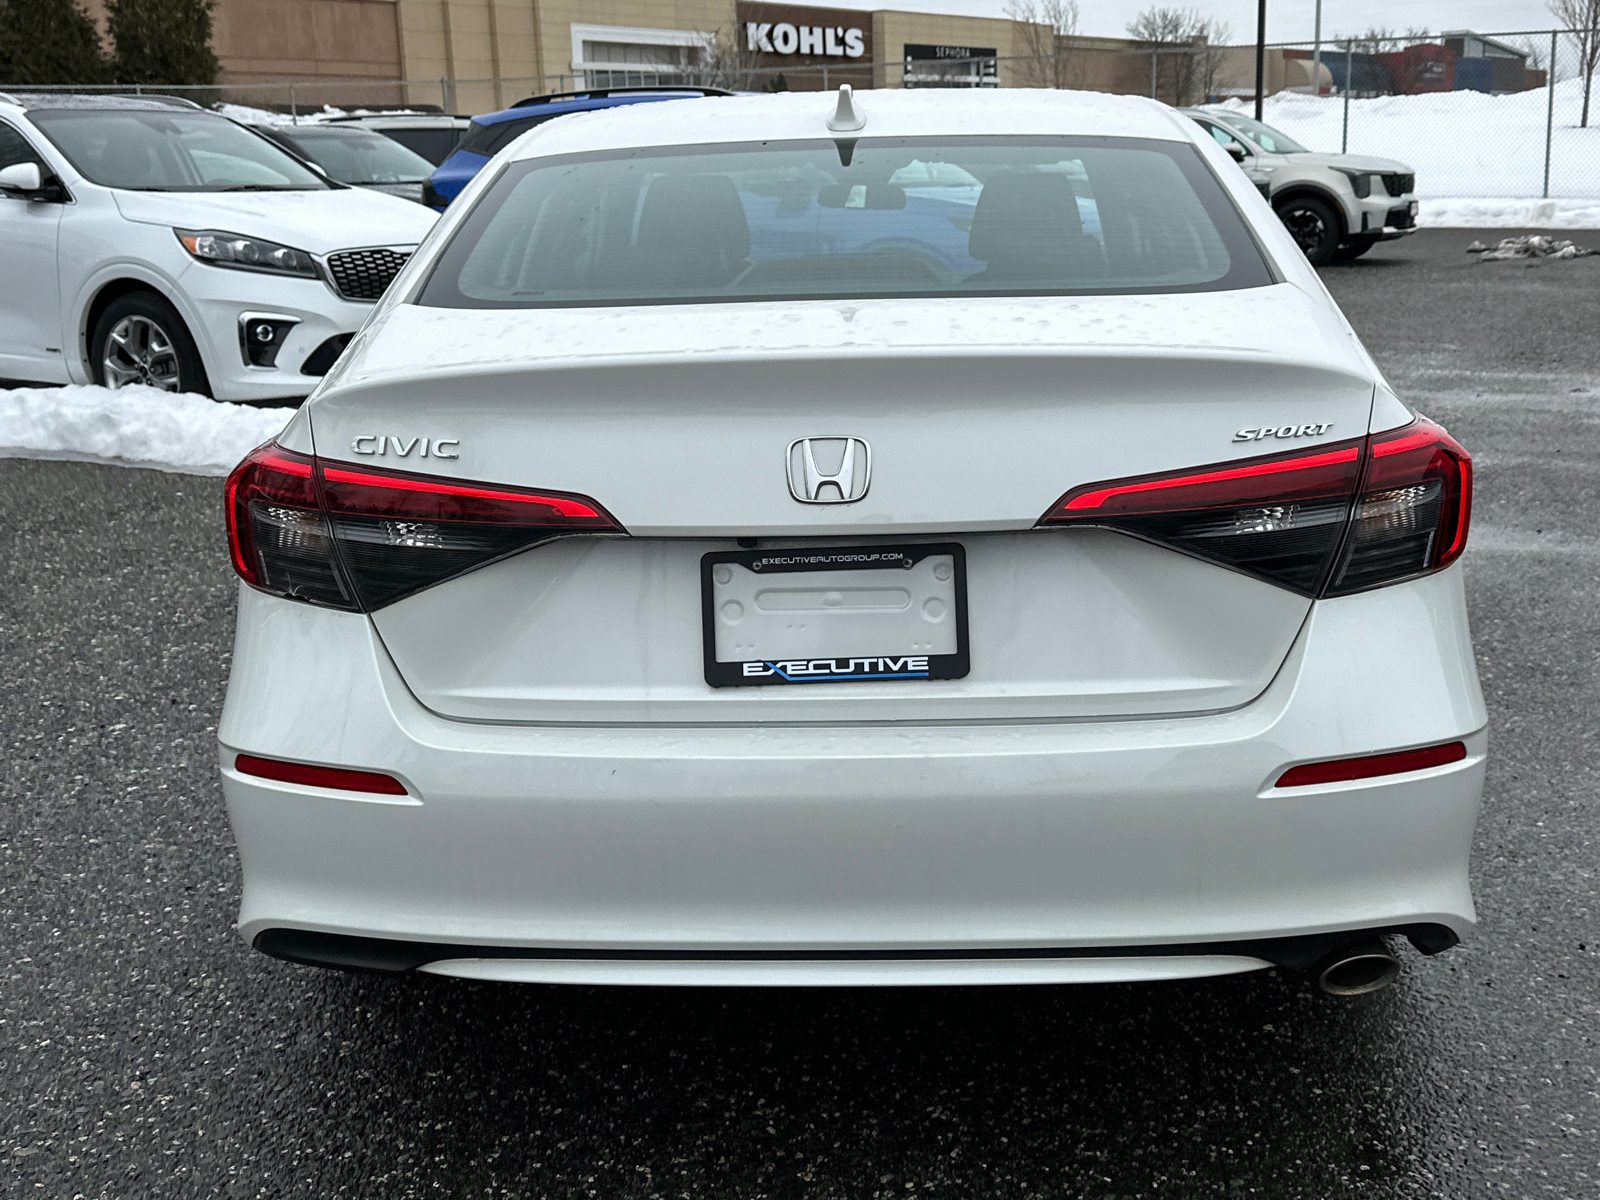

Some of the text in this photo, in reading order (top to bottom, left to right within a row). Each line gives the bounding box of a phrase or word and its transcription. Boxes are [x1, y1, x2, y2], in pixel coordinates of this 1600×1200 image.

[746, 22, 865, 58] KOHL'S
[1231, 422, 1334, 443] SPORT
[351, 435, 460, 459] CIVIC
[761, 553, 904, 565] EXECUTIVEAUTOGROUP.COM
[743, 656, 930, 679] EXECUTIVE
